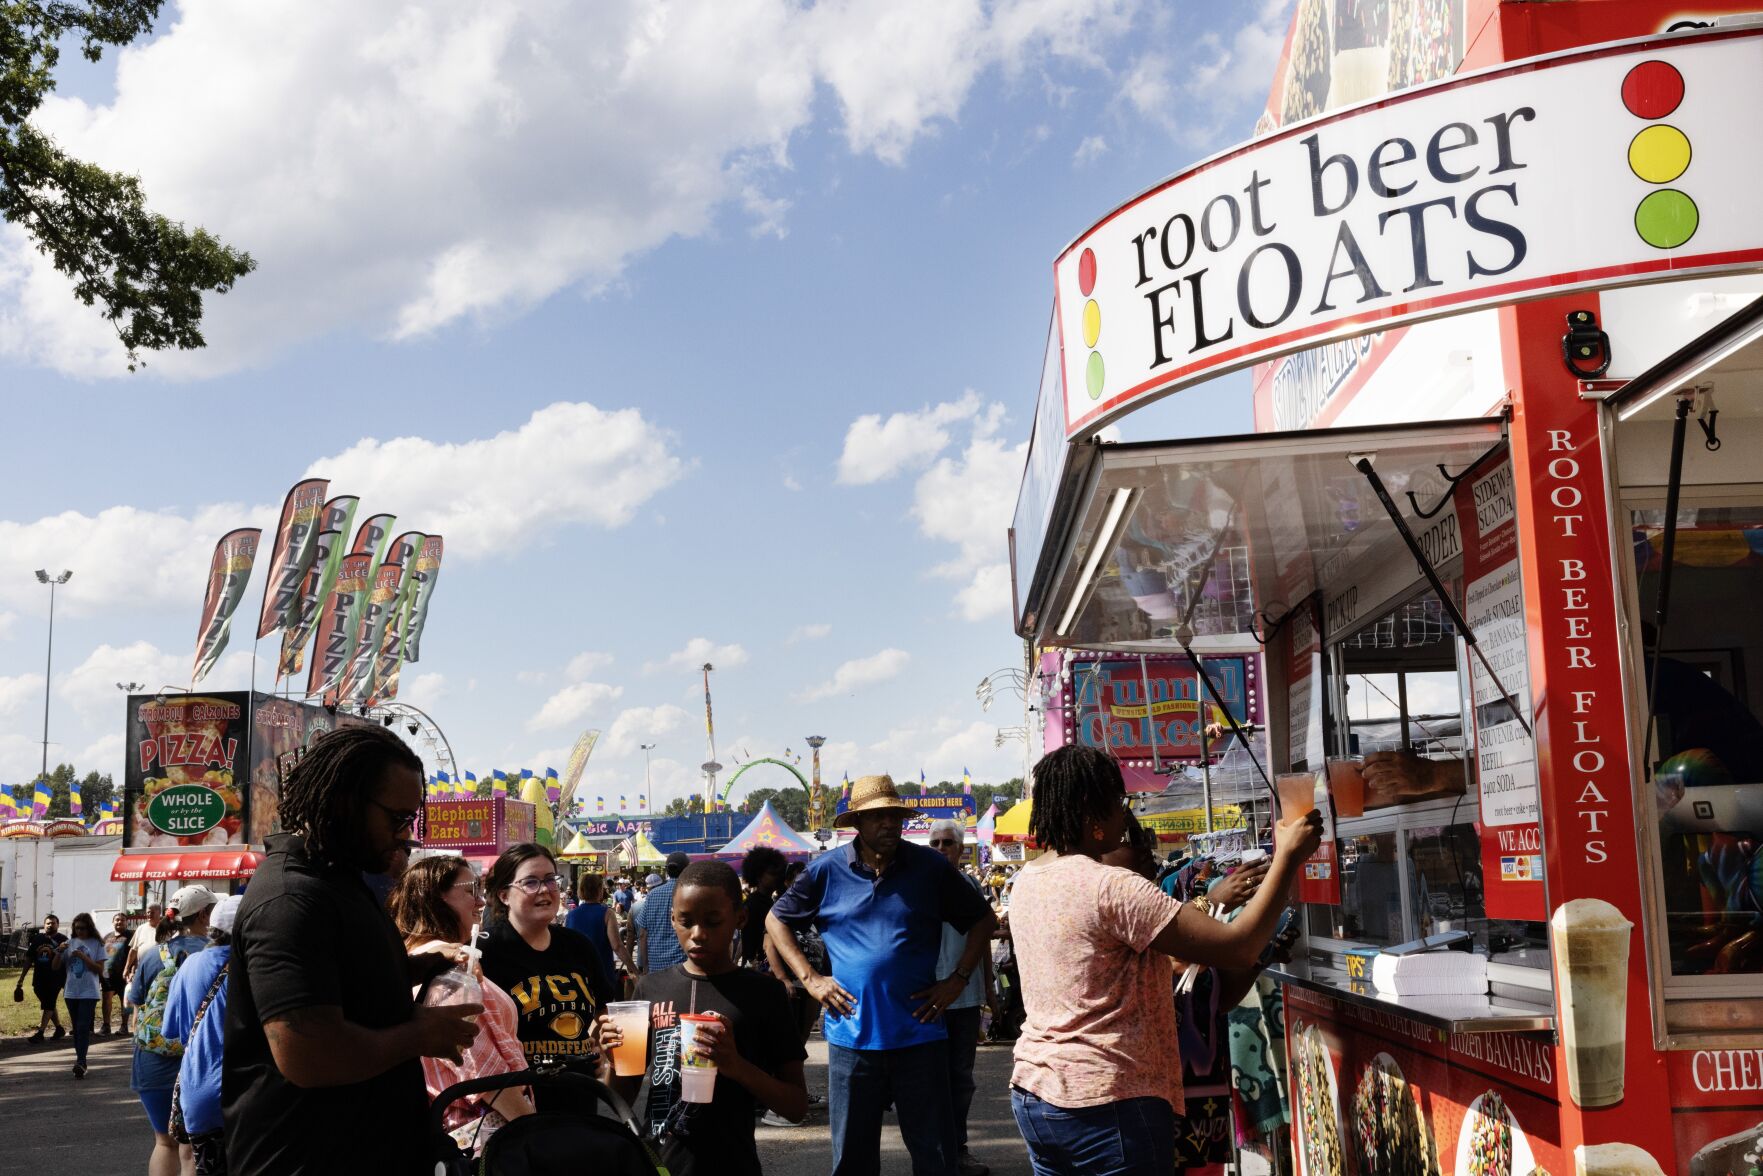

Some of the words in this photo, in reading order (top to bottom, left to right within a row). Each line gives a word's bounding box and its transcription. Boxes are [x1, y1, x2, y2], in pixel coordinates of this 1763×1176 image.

[1131, 169, 1276, 289] root
[1300, 105, 1536, 218] beer
[1143, 181, 1528, 371] FLOATS
[1546, 430, 1583, 537] ROOT
[421, 549, 440, 557] LICE
[338, 570, 368, 580] SLICE
[375, 580, 395, 588] LICE
[1492, 595, 1520, 621] SUNDAE
[1559, 559, 1597, 669] BEER
[138, 706, 184, 722] STROMBOLI
[192, 704, 241, 720] CALZONES
[1163, 701, 1199, 711] FASHIONE
[1080, 712, 1204, 749] Cakes
[1480, 724, 1513, 748] SOUVENIR
[139, 732, 238, 773] PIZZA!
[1481, 751, 1504, 771] REFILL
[1496, 773, 1516, 793] SODA
[1571, 691, 1609, 864] FLOATS
[161, 793, 213, 806] WHOLE
[904, 798, 918, 808] AND
[919, 798, 945, 807] CREDITS
[946, 797, 963, 807] HERE
[180, 807, 189, 815] by
[427, 805, 489, 825] Elephant
[168, 817, 205, 829] SLICE
[431, 825, 460, 839] Ears
[616, 821, 652, 833] MAZE
[1498, 830, 1516, 851] WE
[1518, 828, 1540, 850] ACC
[119, 871, 143, 879] CHEESE
[183, 869, 200, 878] SOFT
[200, 869, 230, 877] PRETZELS
[1504, 863, 1514, 873] VISA
[528, 1002, 592, 1021] FOOTBAL
[652, 1001, 676, 1017] ALL
[653, 1015, 676, 1028] TIME
[1486, 1031, 1552, 1084] BANANAS
